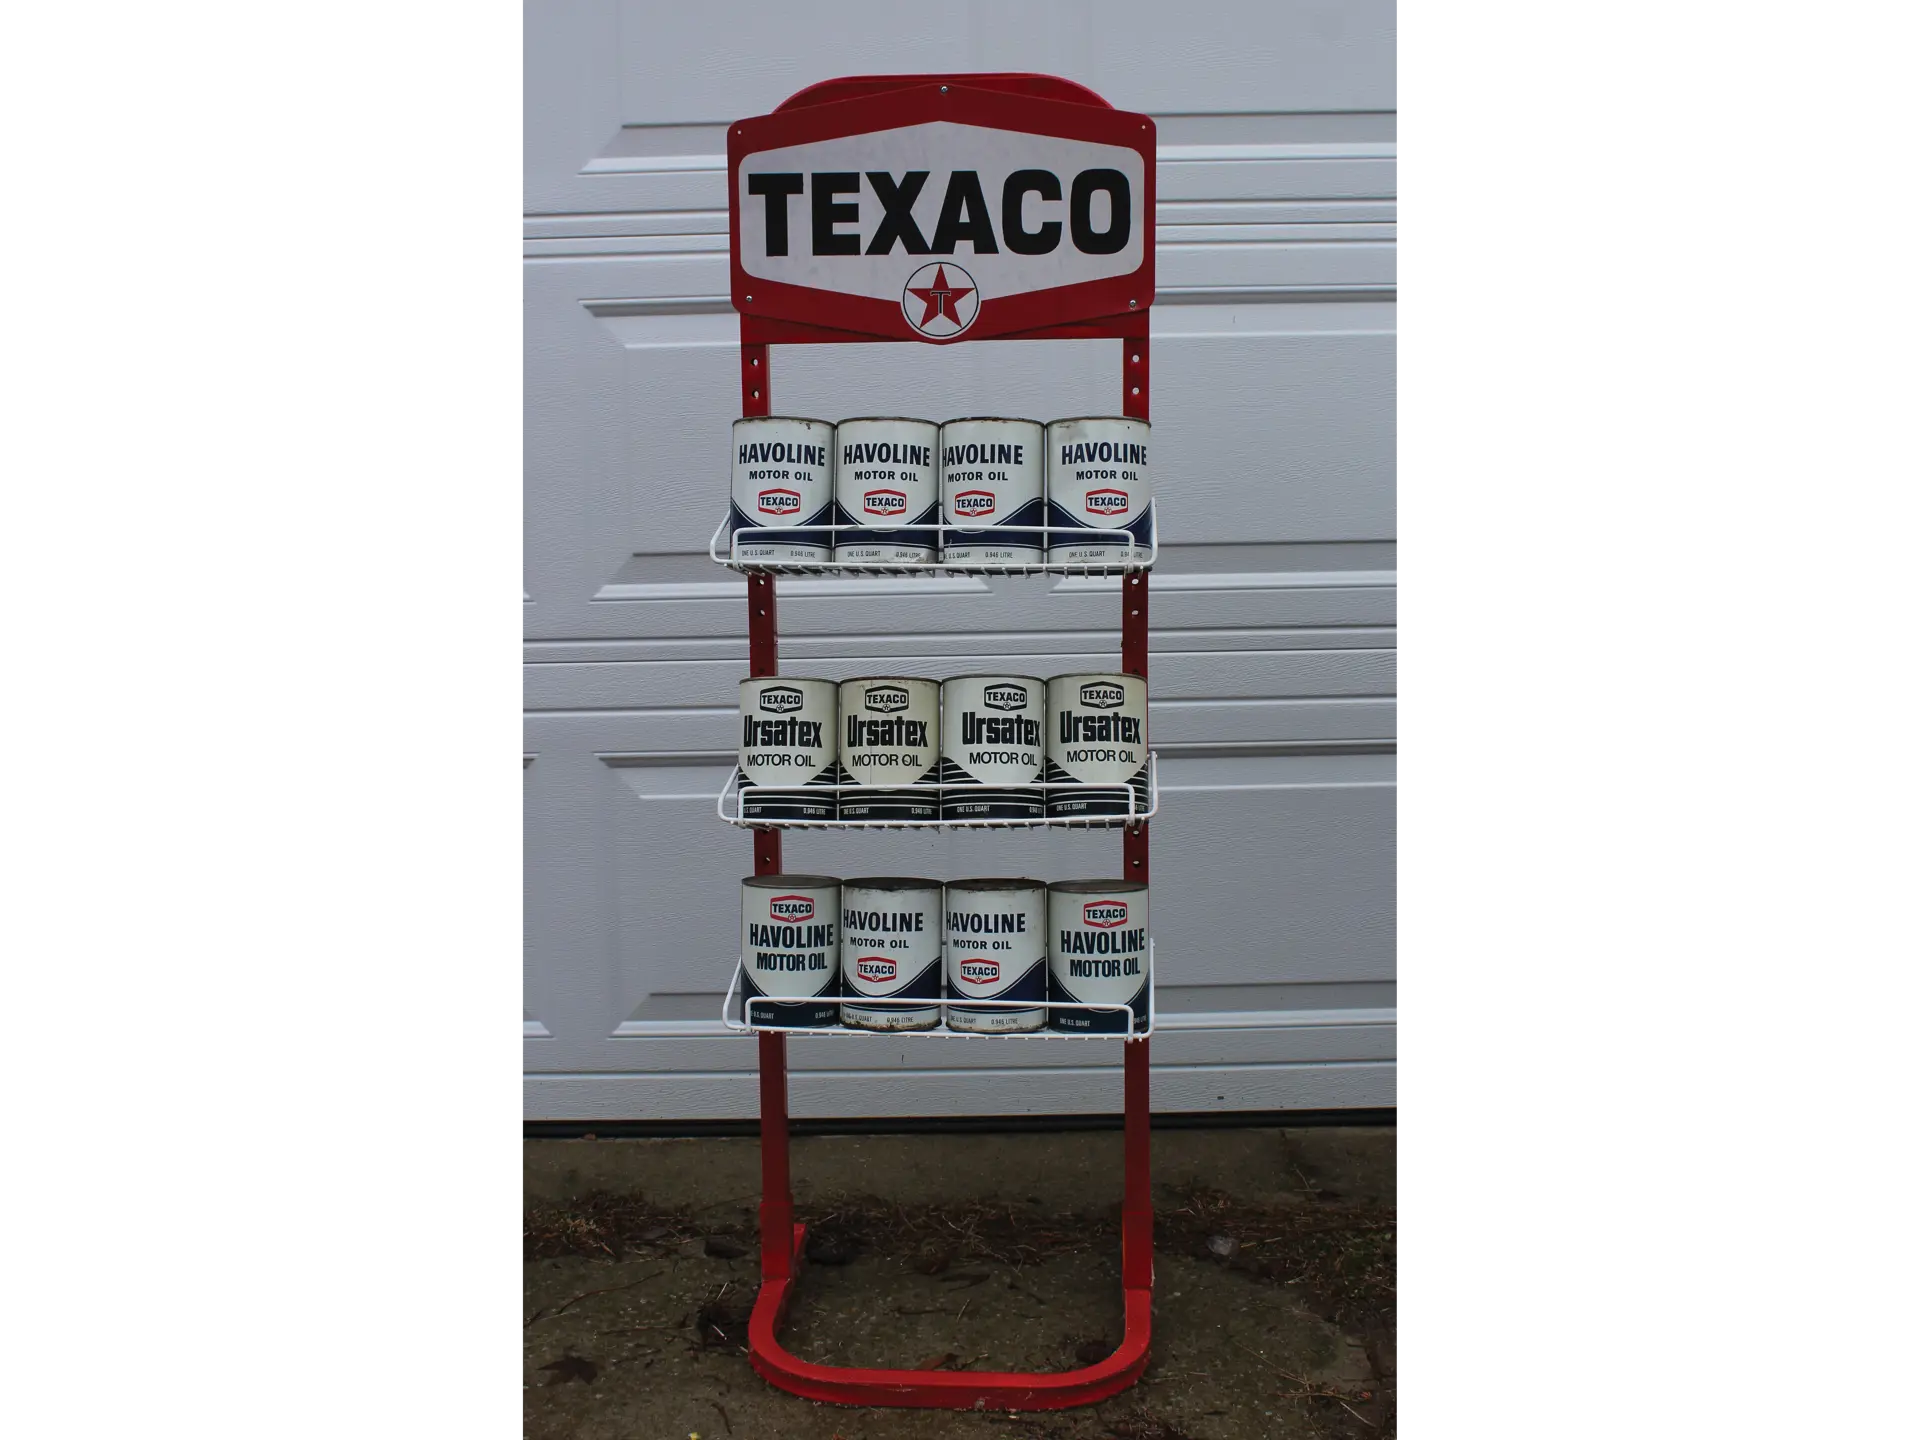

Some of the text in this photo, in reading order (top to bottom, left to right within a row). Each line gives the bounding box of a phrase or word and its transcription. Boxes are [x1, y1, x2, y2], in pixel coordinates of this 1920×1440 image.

[747, 168, 1131, 257] TEXACO
[930, 290, 952, 315] T
[739, 443, 825, 467] HAVOLINE
[844, 443, 930, 467] HAVOLINE
[1061, 442, 1147, 466] HAVOLINE
[749, 470, 813, 481] MOTOR OIL
[854, 470, 918, 482] MOTOR OIL
[947, 471, 1008, 483] MOTOR OIL
[1076, 470, 1138, 481] MOTOR OIL
[760, 497, 798, 507] TEXACO
[866, 497, 904, 507] TEXACO
[956, 498, 993, 509] TEXACO
[1088, 497, 1127, 507] TEXACO
[1000, 551, 1013, 559] LITRE
[762, 694, 801, 705] TEXACO
[867, 694, 907, 704] TEXACO
[986, 691, 1025, 702] TEXACO
[1082, 690, 1122, 700] TEXACO
[743, 714, 823, 748] Ursatex
[847, 714, 928, 748] Ursatex
[962, 711, 1041, 747] Ursatex
[1060, 710, 1141, 745] Ursatex
[747, 754, 816, 767] MOTOR OIL
[852, 754, 922, 767] MOTOR OIL
[969, 751, 1038, 766] MOTOR OIL
[1066, 749, 1137, 764] MOTOR OIL
[772, 903, 812, 914] TEXACO
[1086, 908, 1126, 919] TEXACO
[750, 923, 834, 948] HAVOLINE
[1060, 928, 1145, 954] HAVOLINE
[850, 937, 909, 949] MOTOR OIL
[952, 939, 1012, 950] MOTOR OIL
[757, 952, 827, 971] MOTOR OIL
[1070, 957, 1140, 978] MOTOR OIL
[858, 964, 894, 975] TEXACO
[962, 965, 998, 976] TEXACO
[760, 1012, 774, 1020] QUART
[1005, 1017, 1018, 1025] LITRE
[1075, 1019, 1090, 1027] QUART
